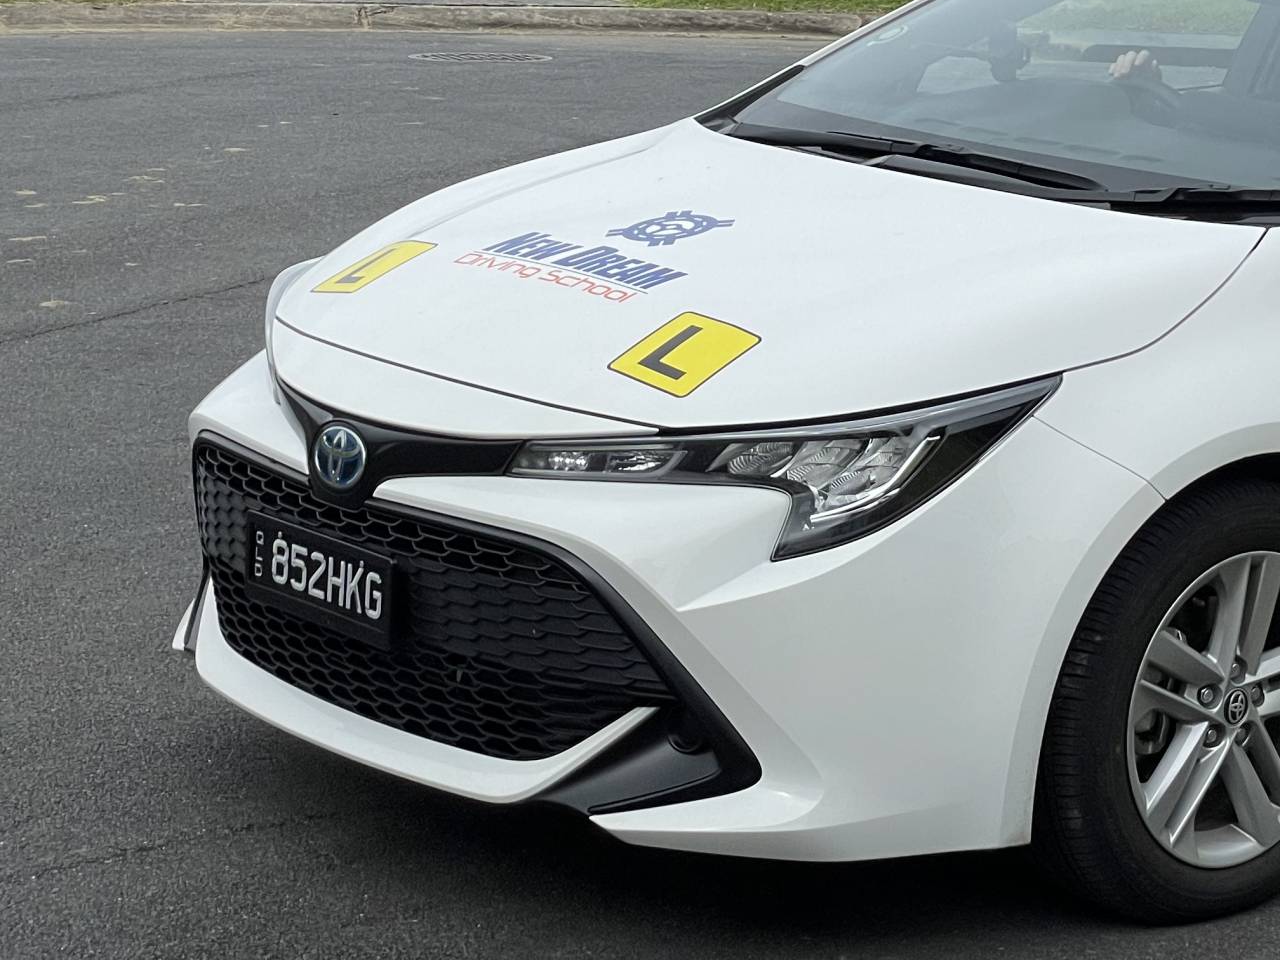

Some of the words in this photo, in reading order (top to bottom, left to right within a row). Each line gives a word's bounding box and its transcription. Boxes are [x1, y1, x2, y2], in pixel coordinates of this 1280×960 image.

[335, 247, 397, 284] L
[453, 252, 541, 279] Driving
[539, 270, 638, 303] School
[638, 325, 703, 381] L
[271, 538, 383, 620] 852HKG
